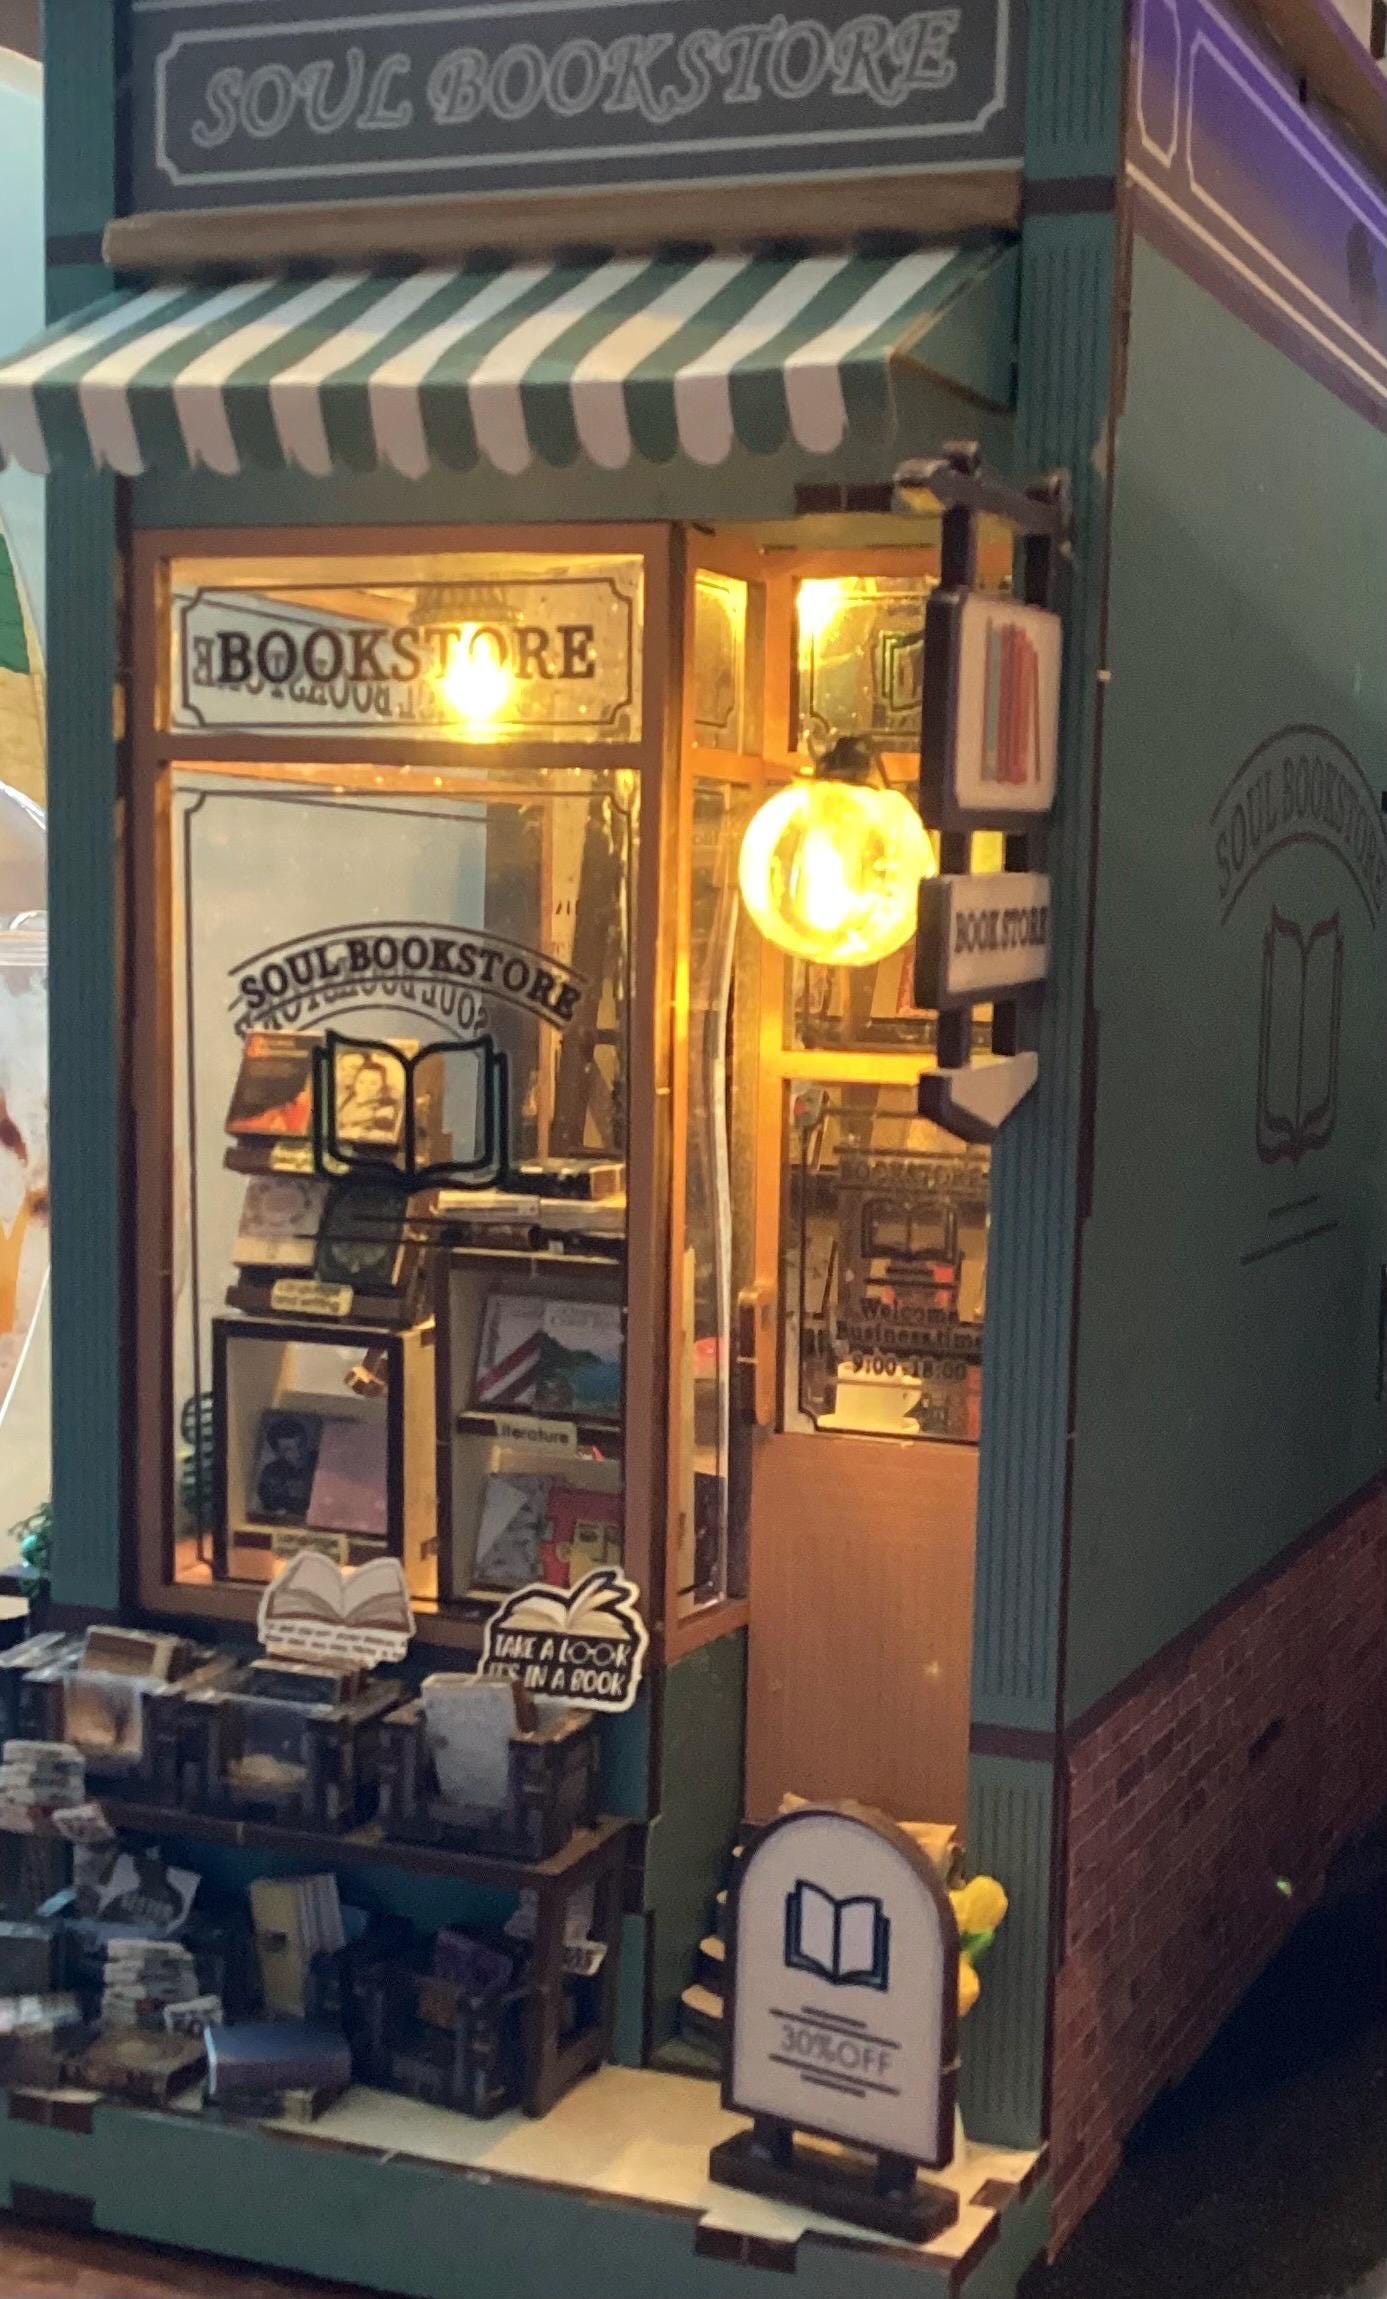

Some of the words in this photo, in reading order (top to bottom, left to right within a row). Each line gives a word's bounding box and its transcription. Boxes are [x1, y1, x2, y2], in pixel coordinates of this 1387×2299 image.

[191, 46, 414, 148] SOUL
[427, 7, 962, 126] BOOKSTORE
[240, 945, 342, 1009] SOUL
[347, 935, 583, 1022] BOOKSTORE
[494, 1634, 537, 1659] TAKE
[539, 1638, 554, 1661] A
[558, 1639, 631, 1667] LOOK
[523, 1665, 548, 1688] IN
[551, 1668, 565, 1690] A
[570, 1669, 626, 1696] BOOK
